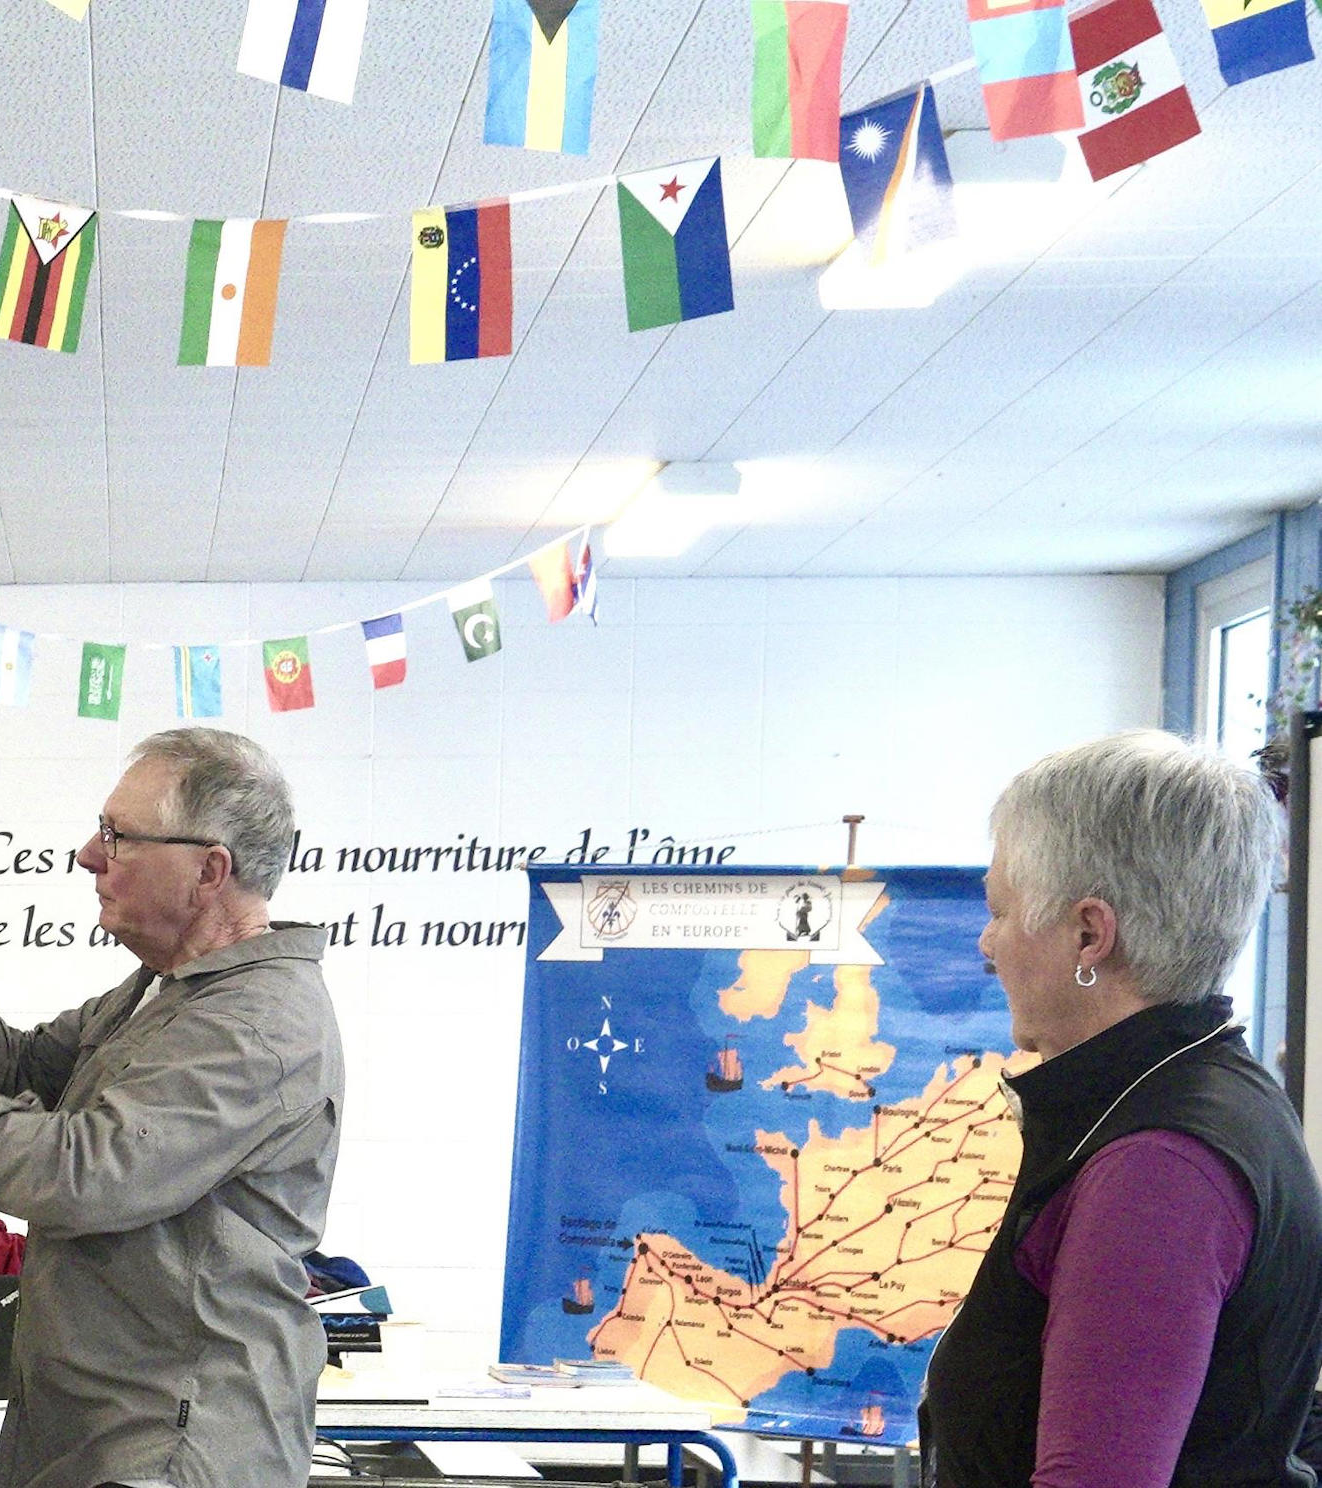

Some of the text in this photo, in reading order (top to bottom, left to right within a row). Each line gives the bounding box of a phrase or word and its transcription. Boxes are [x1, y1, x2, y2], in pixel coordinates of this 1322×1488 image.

[288, 829, 325, 873] la
[336, 834, 547, 873] nourriture
[564, 827, 610, 865] de
[641, 882, 768, 895] LES CHEMINS DE
[23, 904, 75, 948] les
[371, 903, 409, 947] la
[652, 925, 749, 938] EN "EUROPE"
[600, 996, 613, 1010] N
[566, 1037, 580, 1052] O
[634, 1038, 646, 1053] E
[598, 1081, 608, 1096] S
